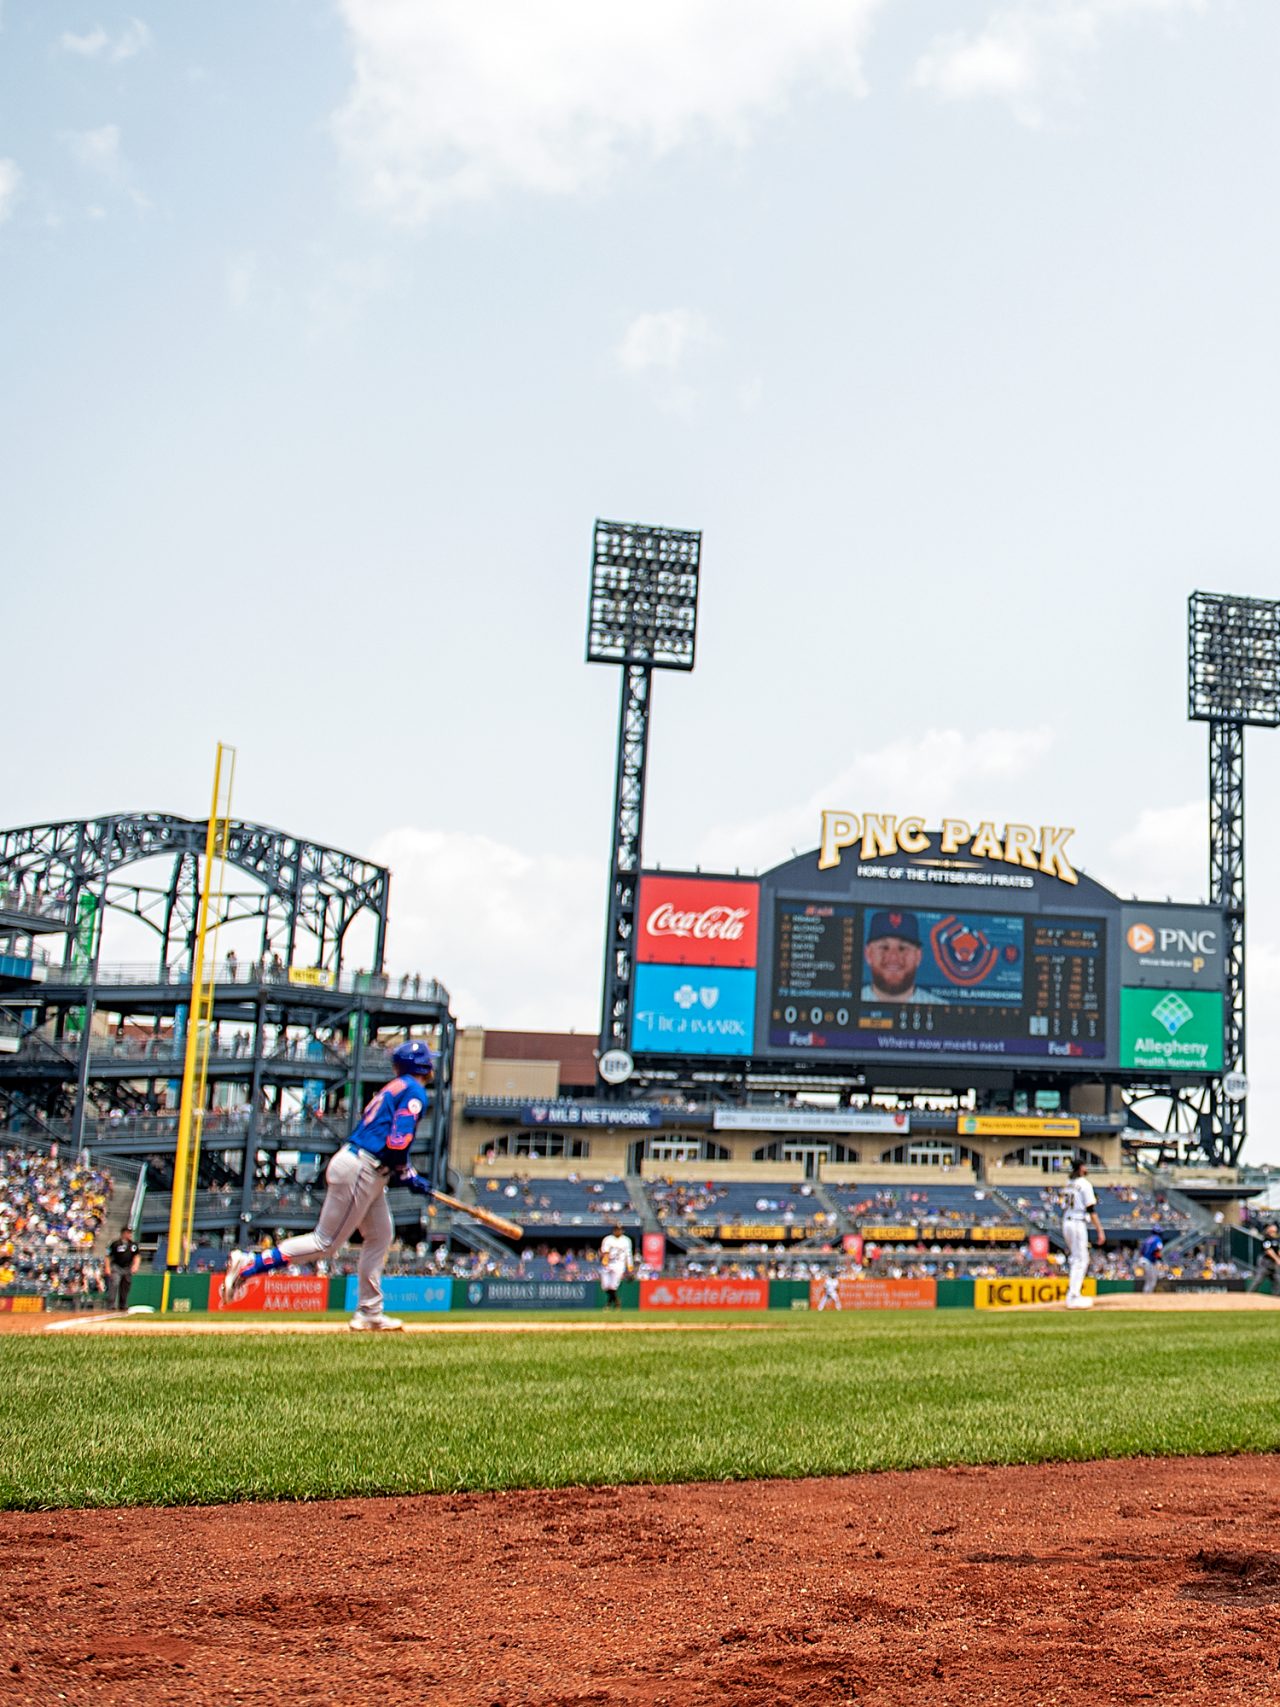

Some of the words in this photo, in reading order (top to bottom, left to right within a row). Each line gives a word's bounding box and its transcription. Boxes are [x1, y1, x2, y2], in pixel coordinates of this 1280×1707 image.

[818, 809, 931, 871] PNC
[940, 818, 1079, 886] PARK
[857, 865, 888, 879] HOME
[888, 867, 904, 880] OF
[905, 868, 928, 882] THE
[927, 870, 992, 886] PITTSBURGH
[992, 873, 1035, 889] PIRATES
[1158, 927, 1217, 955] PNC
[784, 1006, 798, 1024] 0
[810, 1007, 823, 1025] 0
[836, 1008, 849, 1026] 0
[877, 1035, 915, 1049] Where
[917, 1039, 942, 1050] now
[943, 1040, 978, 1051] meets
[979, 1041, 1005, 1052] next
[1134, 1037, 1209, 1058] Allegheny
[549, 1107, 579, 1123] MLB
[581, 1108, 650, 1125] NETWORK
[264, 1279, 322, 1294] Insurance
[988, 1284, 1012, 1305] IC
[1019, 1285, 1085, 1304] LIGH
[264, 1296, 321, 1311] AAA.com
